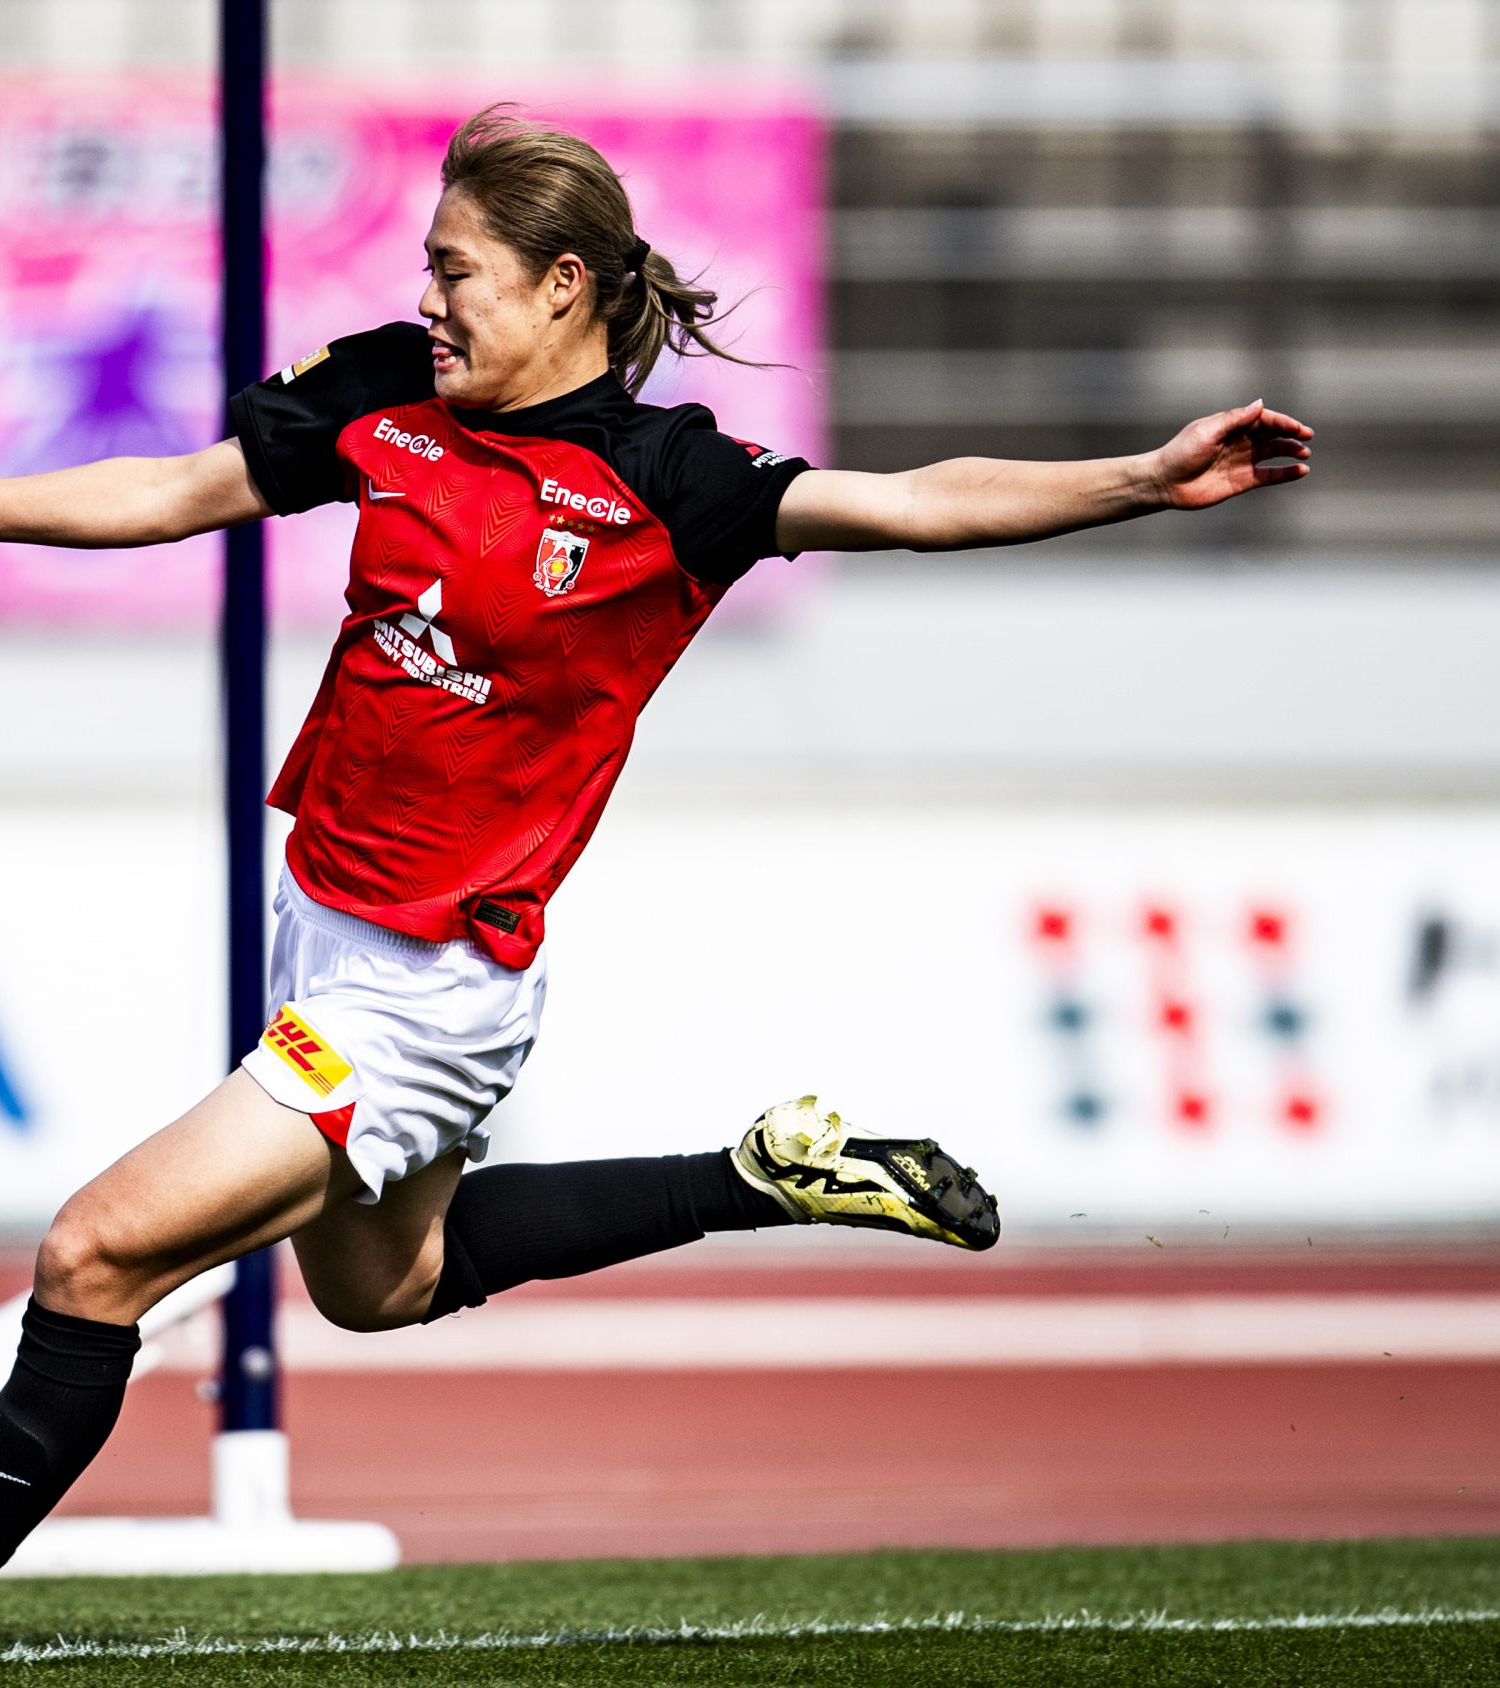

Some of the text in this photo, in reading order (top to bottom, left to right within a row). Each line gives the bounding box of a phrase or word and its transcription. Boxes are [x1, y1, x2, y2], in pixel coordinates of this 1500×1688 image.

[373, 417, 444, 461] EneCle
[541, 478, 631, 525] EneCle
[373, 619, 492, 695] MITSUBISHI
[373, 629, 487, 705] HEAVY INDUSTRIES
[891, 1152, 931, 1191] ZOOM
